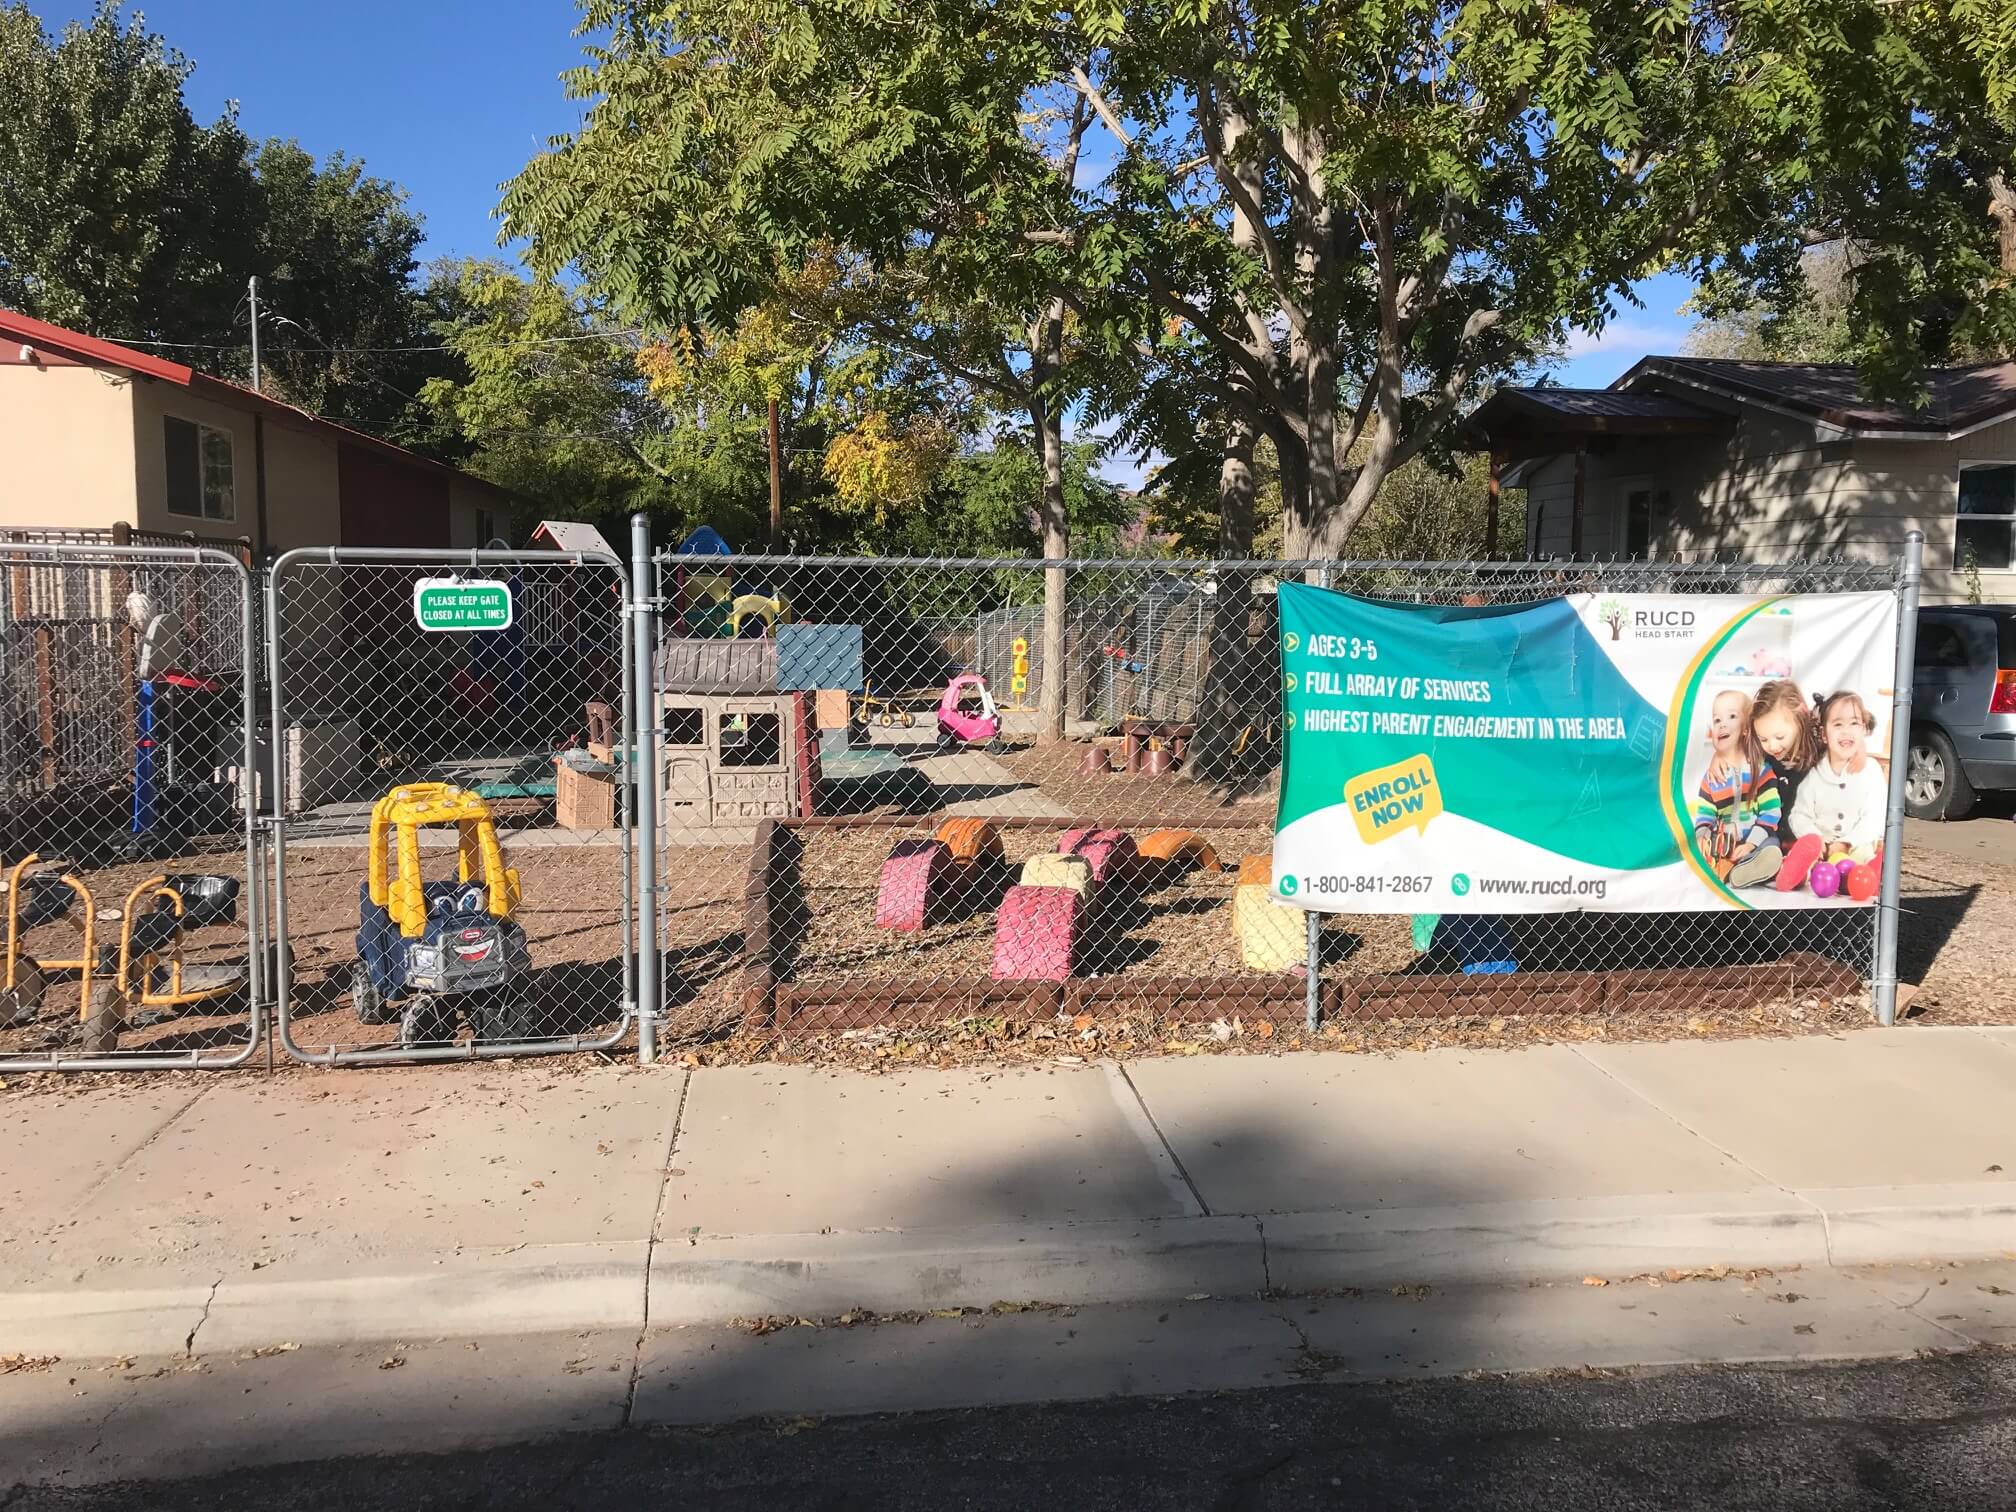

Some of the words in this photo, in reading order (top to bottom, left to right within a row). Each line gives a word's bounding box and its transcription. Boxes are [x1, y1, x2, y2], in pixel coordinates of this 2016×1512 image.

[428, 596, 456, 606] PLEASE
[459, 595, 478, 606] KEEP
[480, 595, 499, 605] GATE
[423, 610, 453, 620] CLOSED
[455, 610, 464, 620] AT
[467, 610, 481, 619] ALL
[483, 609, 506, 619] TIMES
[1635, 611, 1695, 626] RUCD
[1307, 634, 1347, 658] AGES
[1350, 637, 1378, 661] 3-5
[1305, 671, 1343, 695] FULL
[1346, 674, 1398, 698] ARRAY
[1400, 677, 1421, 699] OF
[1423, 678, 1491, 703] SERVICES
[1304, 709, 1369, 733] HIGHEST
[1372, 712, 1431, 736] PARENT
[1433, 715, 1536, 739] ENGAGEMENT
[1538, 717, 1554, 739] IN
[1556, 717, 1585, 740] THE
[1588, 717, 1626, 740] AREA
[1353, 768, 1431, 812] ENROLL
[1371, 792, 1424, 828] NOW
[1303, 876, 1433, 894] 1-800-841-2867
[1479, 875, 1607, 899] www.rucd.org
